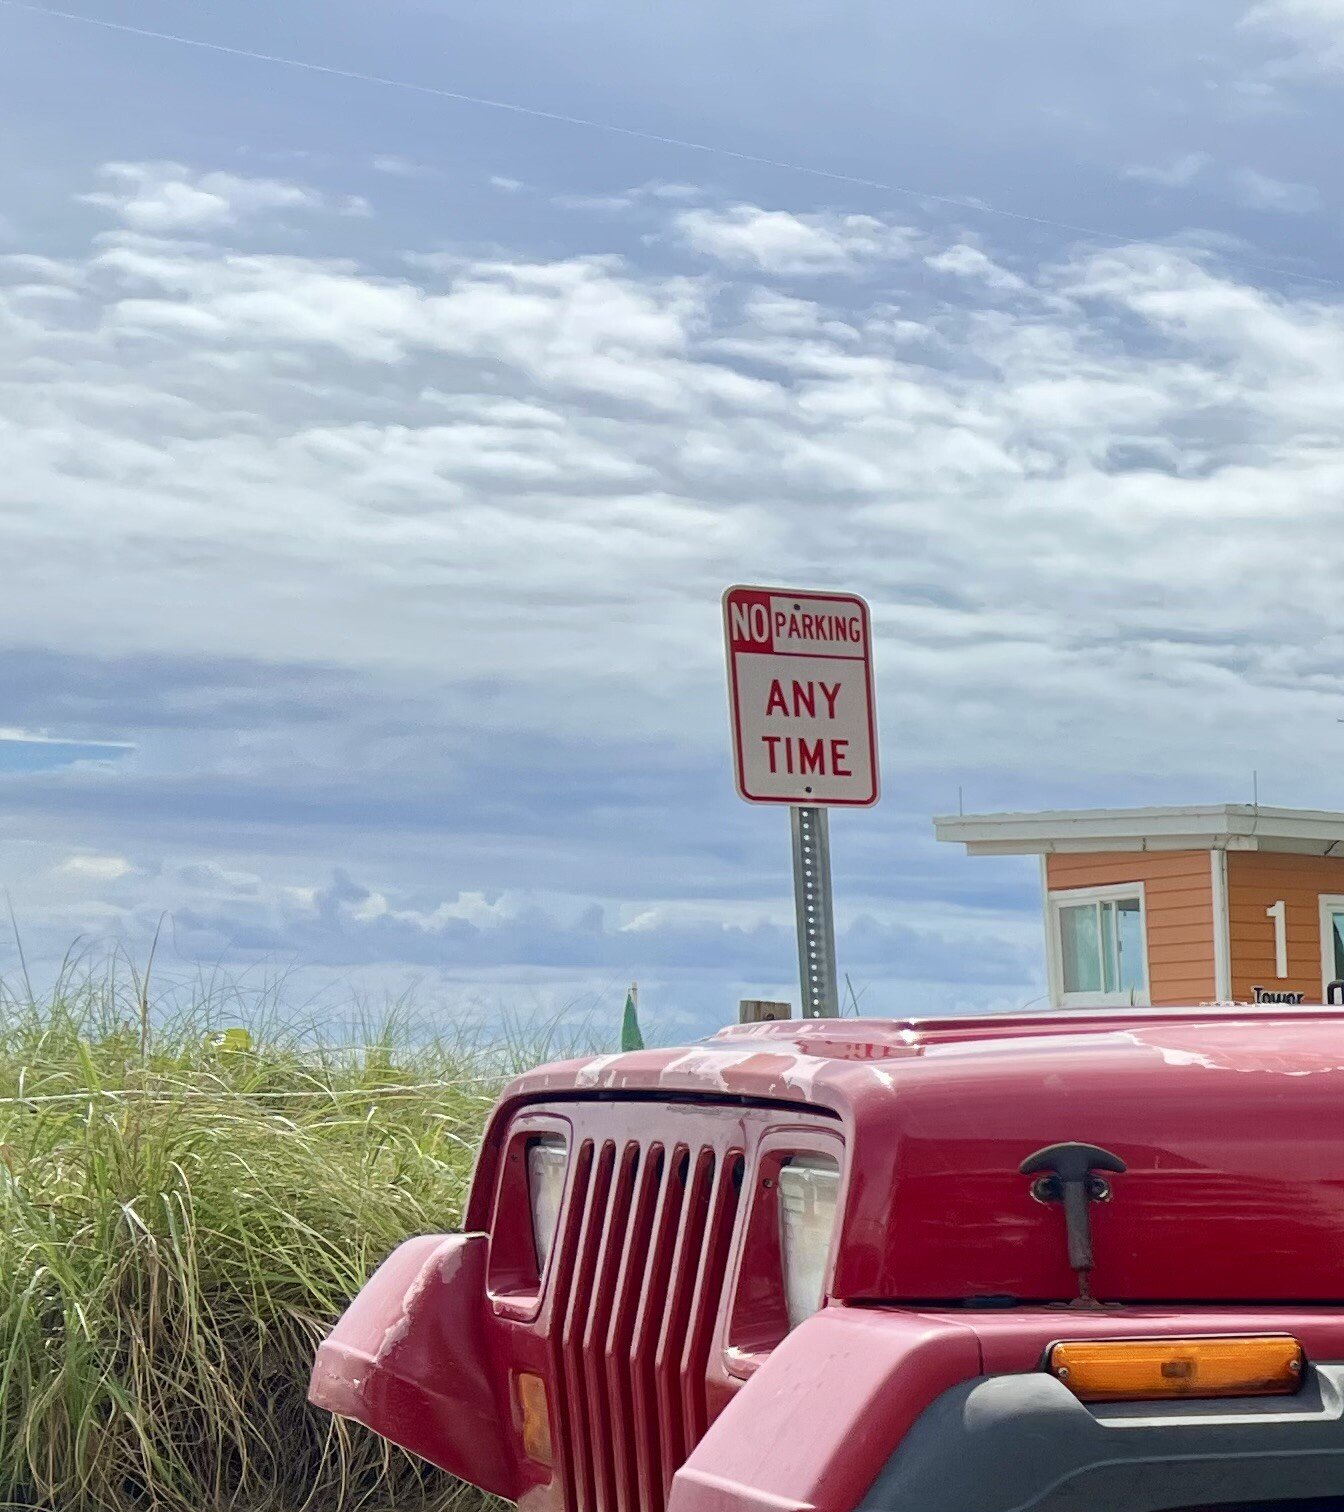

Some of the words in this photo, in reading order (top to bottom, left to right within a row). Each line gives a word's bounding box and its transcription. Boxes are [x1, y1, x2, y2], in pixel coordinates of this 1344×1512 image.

[730, 601, 770, 643] NO
[775, 611, 861, 643] PARKING
[766, 679, 842, 719] ANY
[761, 735, 852, 776] TIME
[1266, 900, 1288, 978] 1
